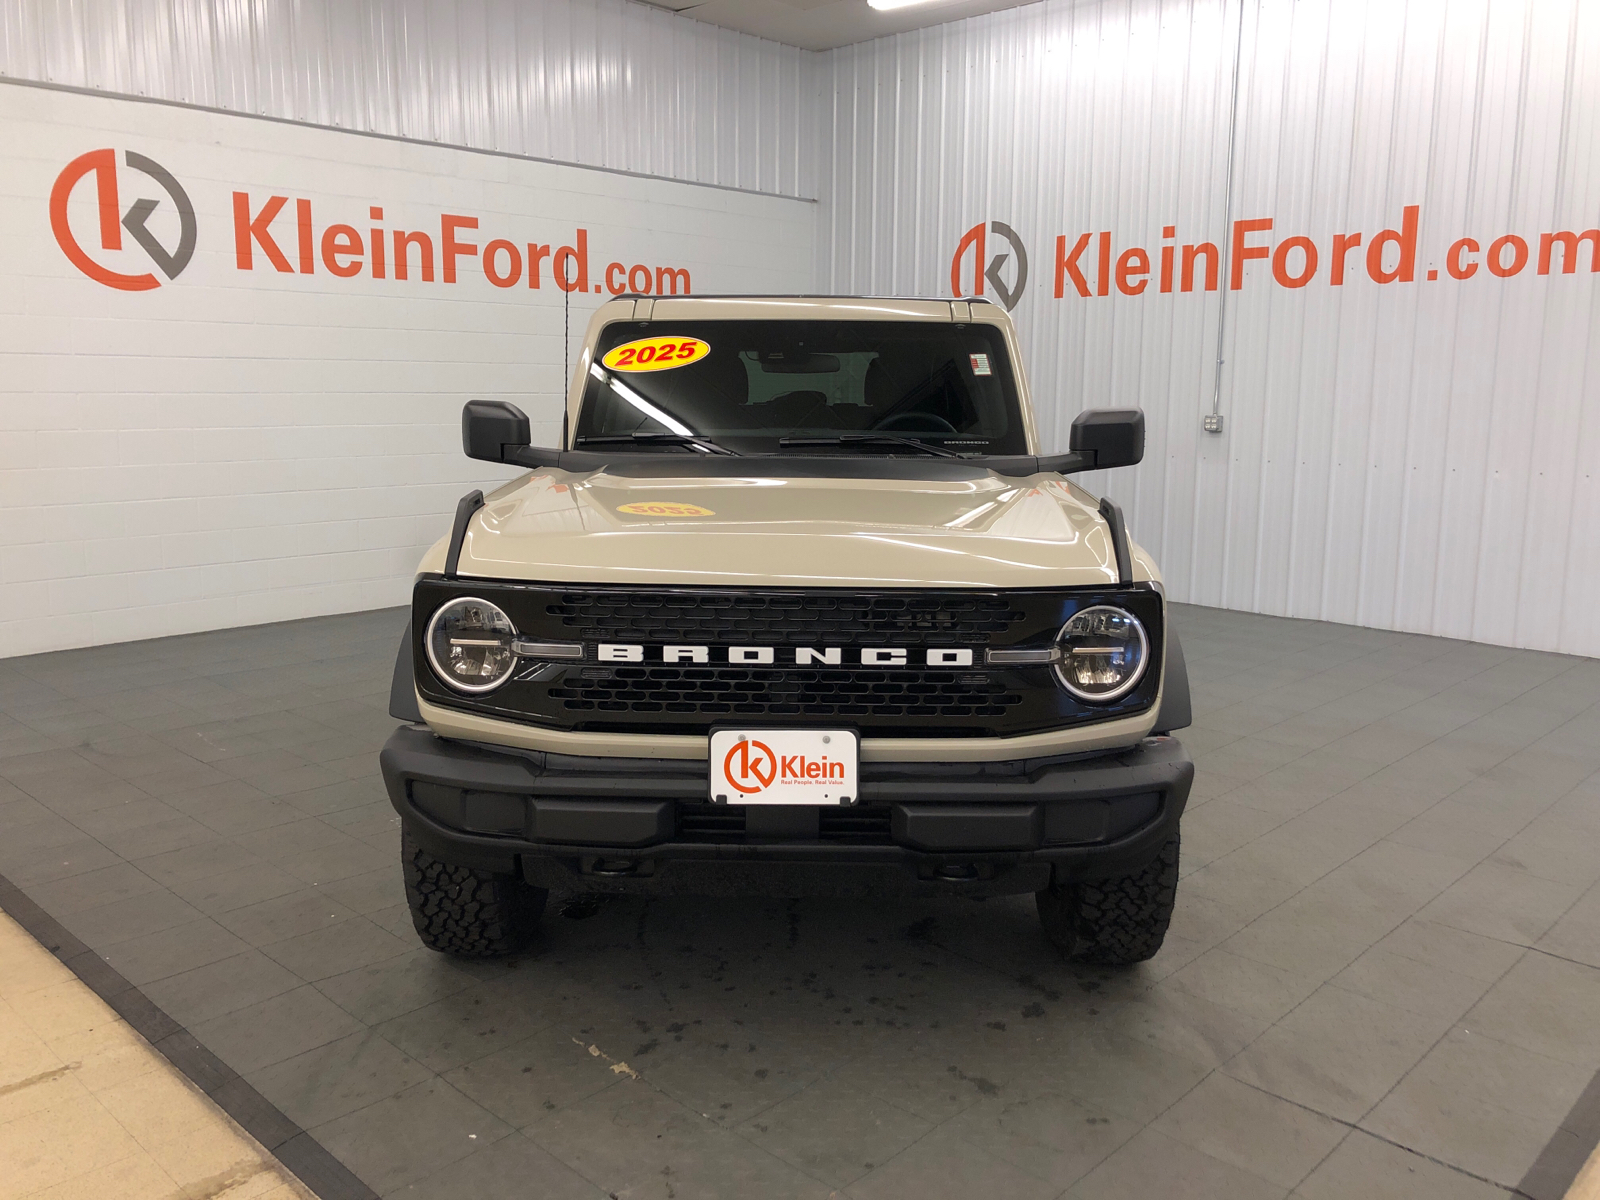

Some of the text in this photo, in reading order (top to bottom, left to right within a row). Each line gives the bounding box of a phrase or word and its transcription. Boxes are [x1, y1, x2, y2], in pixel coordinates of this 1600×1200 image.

[233, 192, 691, 296] KleinFord.com
[1054, 205, 1600, 298] KleinFord.com
[614, 342, 698, 366] 2025
[598, 644, 973, 665] BRONCO
[781, 755, 845, 779] Klein
